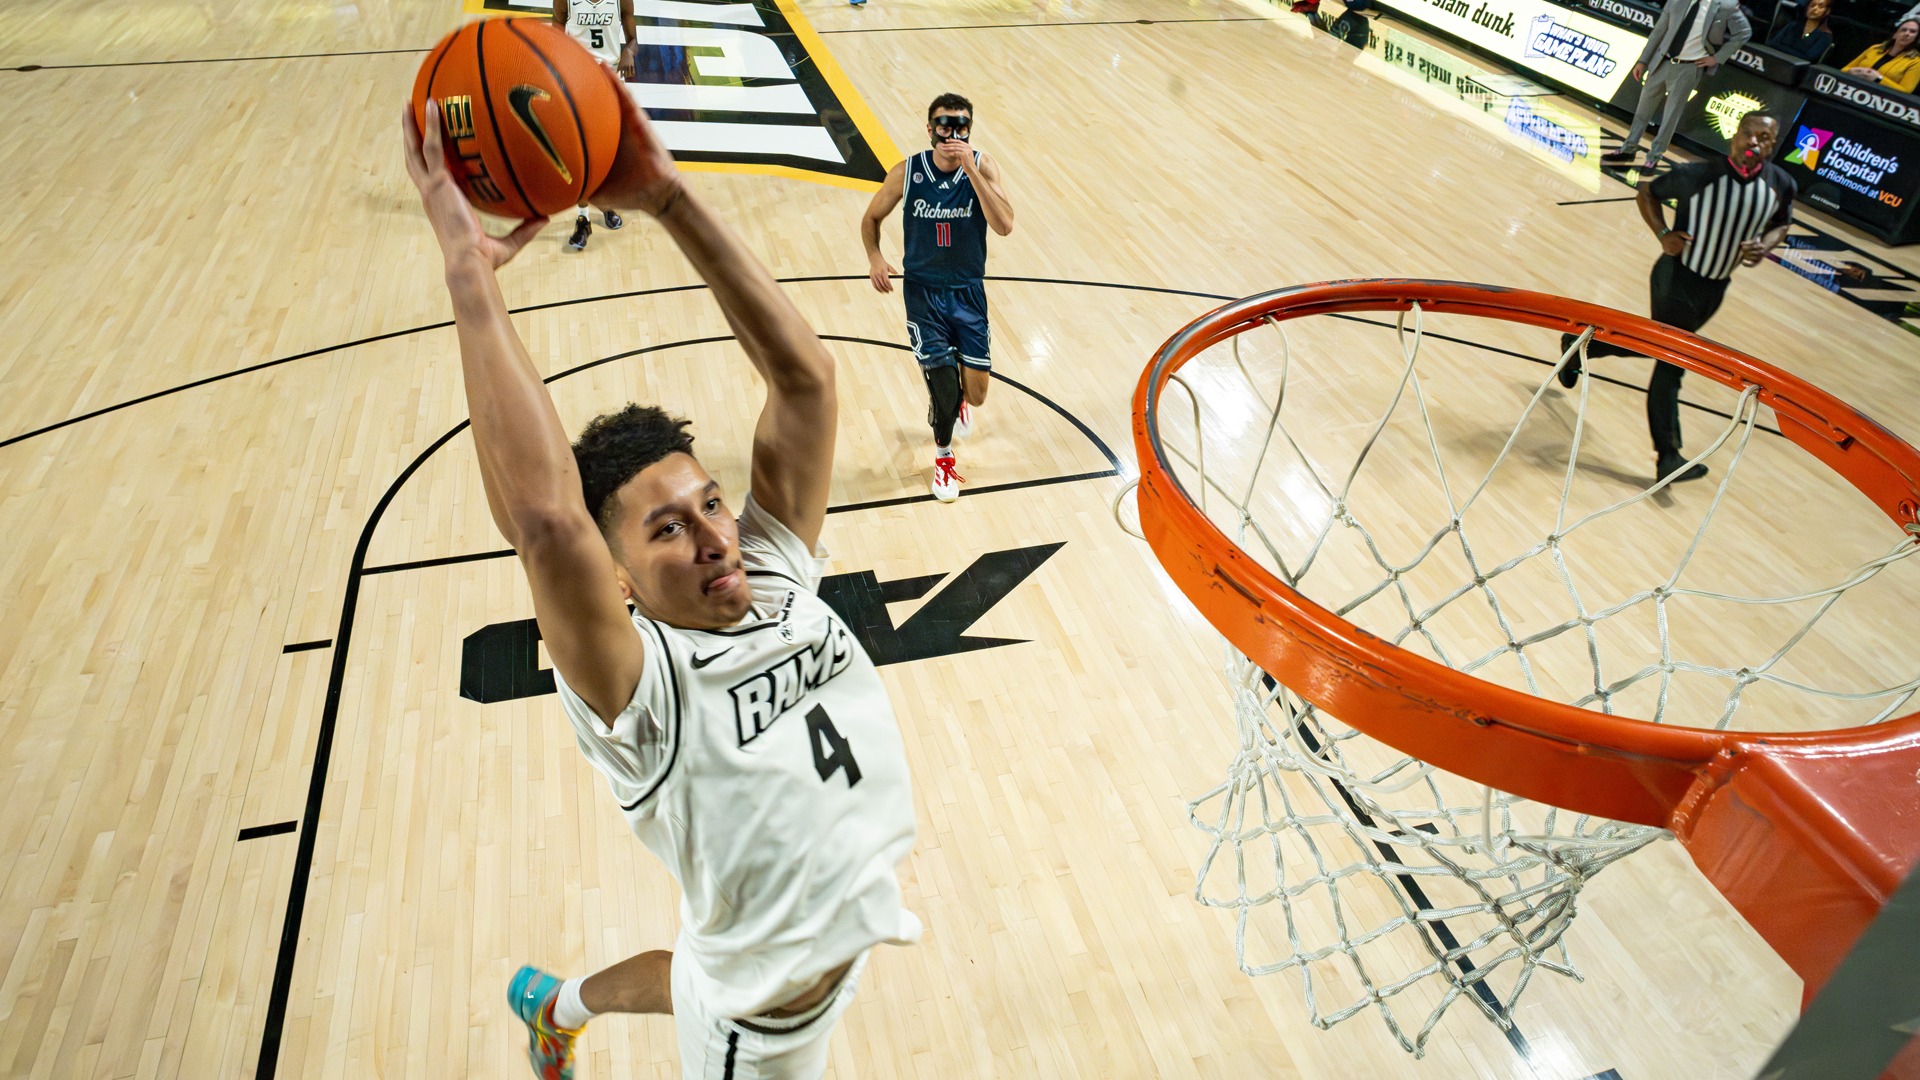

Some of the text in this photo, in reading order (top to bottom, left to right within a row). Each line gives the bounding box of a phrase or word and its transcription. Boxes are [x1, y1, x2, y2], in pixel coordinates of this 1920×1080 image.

[577, 13, 614, 26] RAMS
[1471, 2, 1515, 39] dunk.
[1600, 0, 1655, 28] HONDA
[590, 29, 604, 48] 5
[1533, 33, 1616, 78] GAME PLAN?
[1549, 23, 1609, 57] WHAT'S YOUR
[1709, 100, 1735, 118] DRIVE
[1833, 82, 1920, 125] HONDA
[1823, 150, 1884, 185] Hospital
[1832, 137, 1899, 174] Children's
[1816, 167, 1902, 208] of Richmond at VCU
[912, 198, 973, 219] Richmond
[936, 222, 951, 247] 11
[727, 616, 854, 747] RAMS
[805, 702, 863, 789] 4
